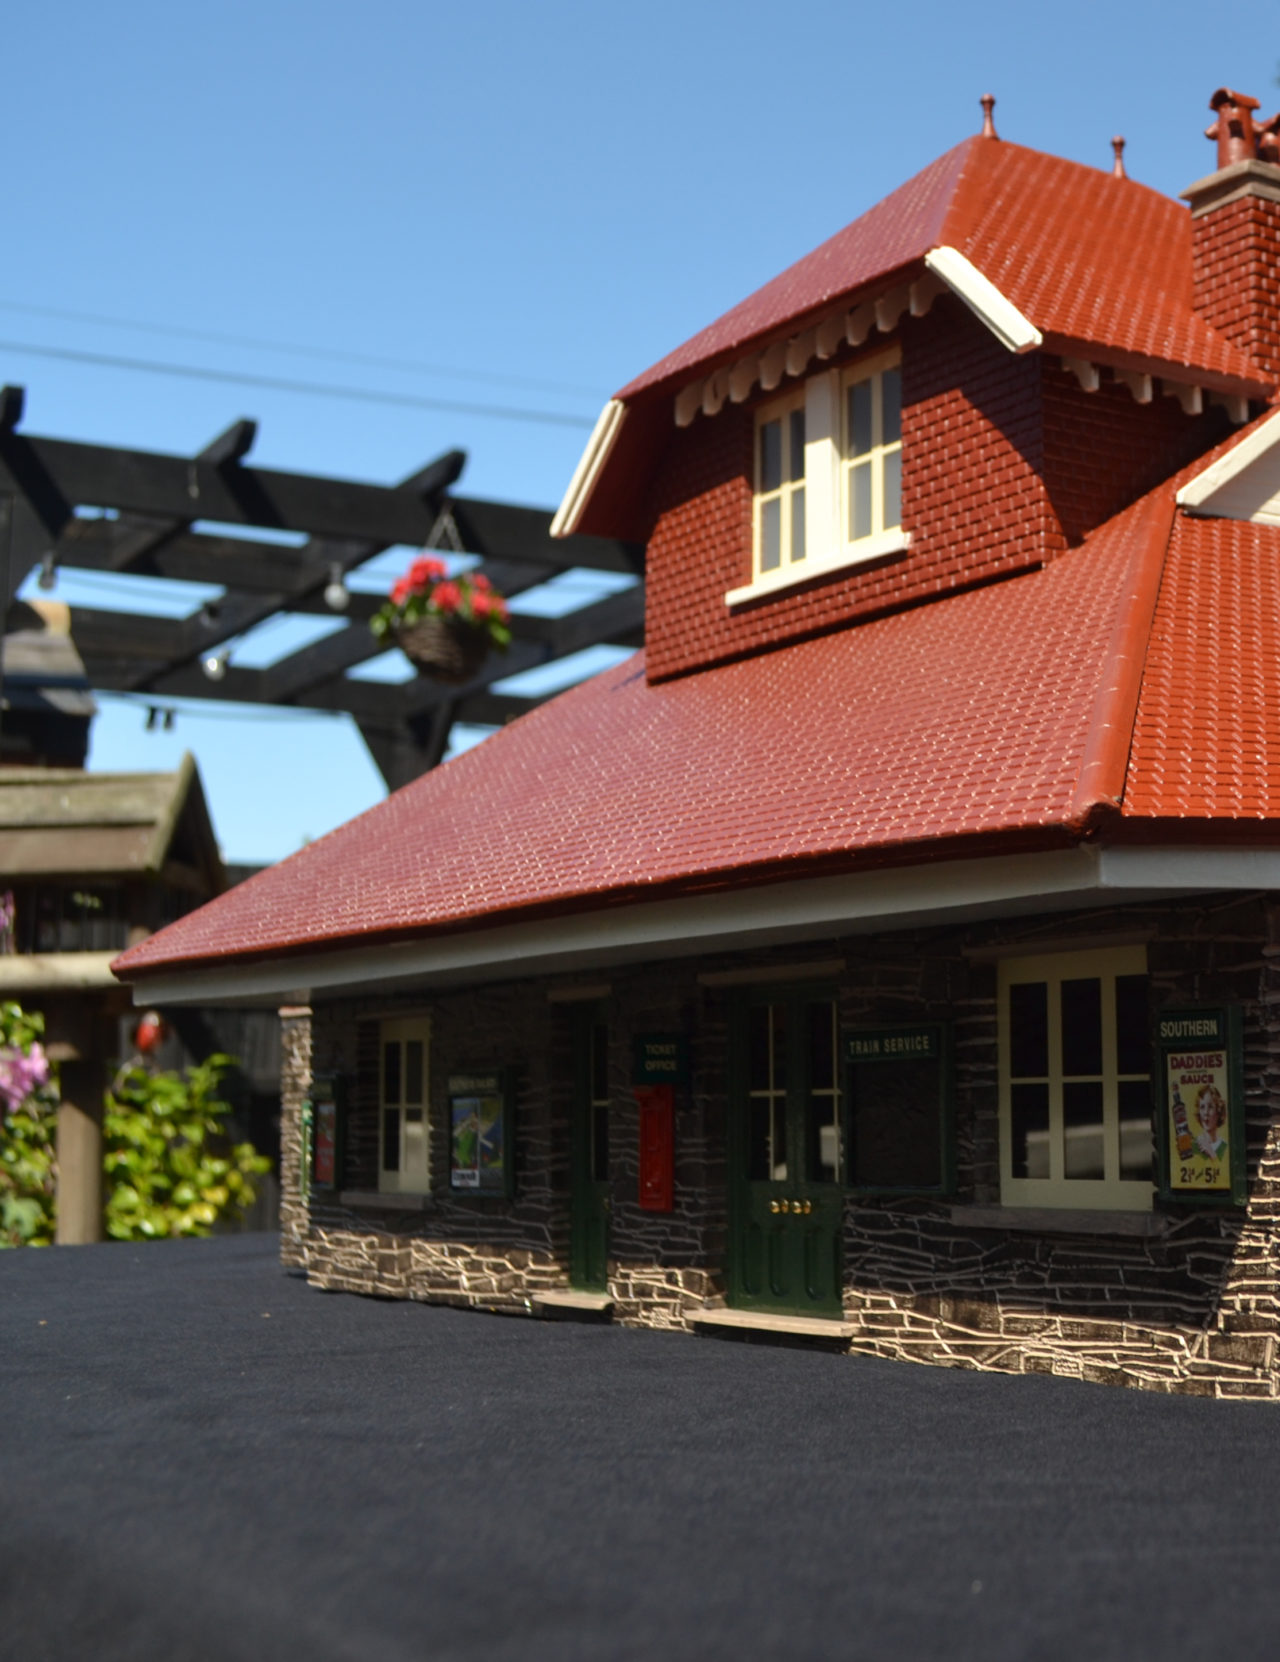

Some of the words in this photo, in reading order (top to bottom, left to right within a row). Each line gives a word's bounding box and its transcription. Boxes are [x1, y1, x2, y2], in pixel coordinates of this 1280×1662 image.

[1160, 1019, 1218, 1038] SOUTHERN
[849, 1039, 880, 1055] TRAIN
[883, 1035, 929, 1053] SERVICE
[644, 1060, 677, 1072] OFFICE
[1170, 1053, 1223, 1070] DADDIES
[1180, 1074, 1214, 1085] SAUCE
